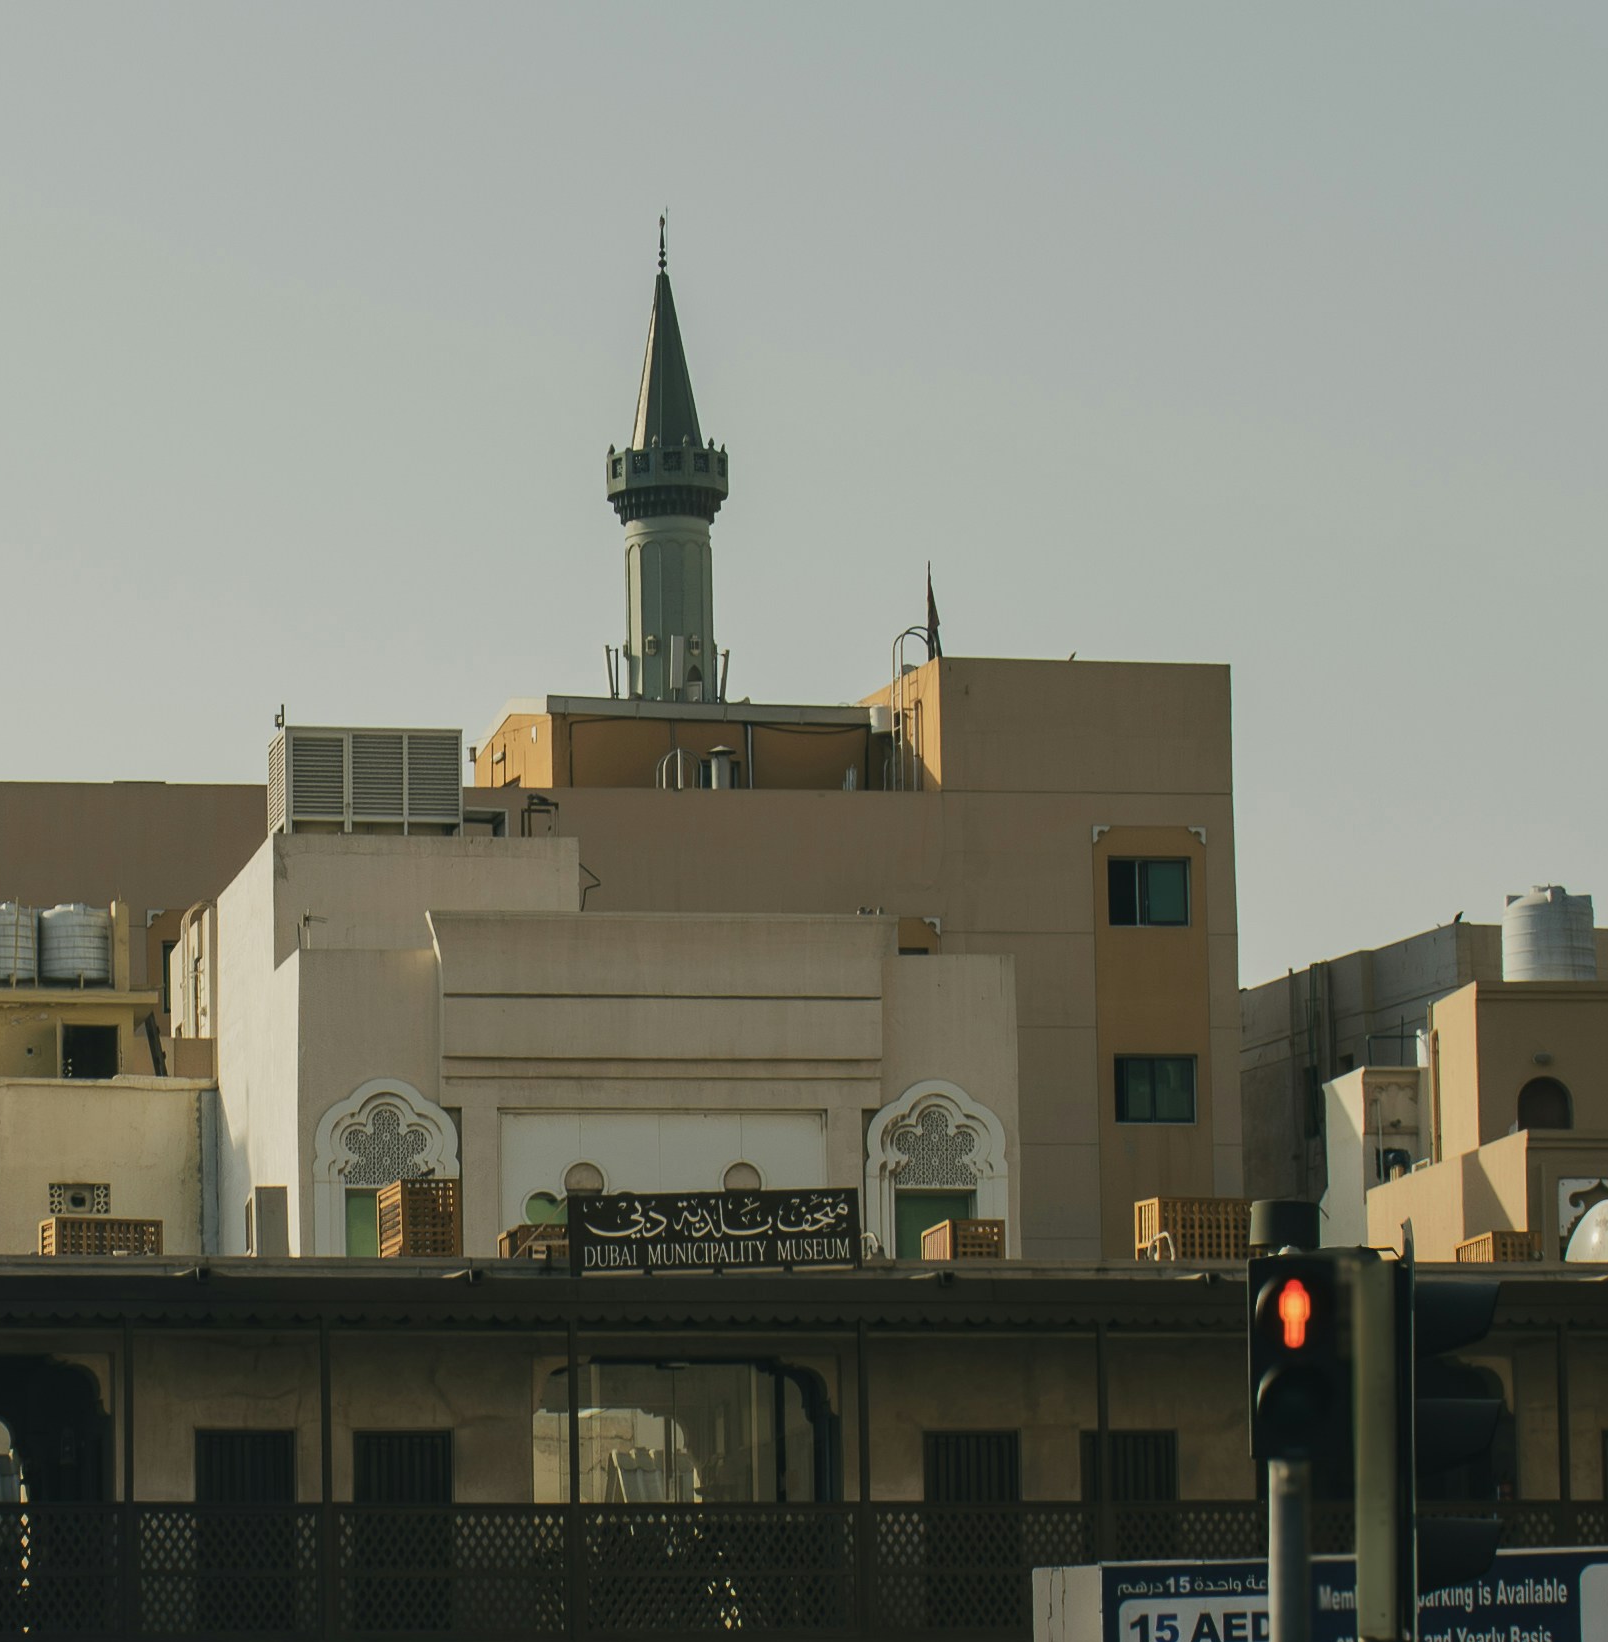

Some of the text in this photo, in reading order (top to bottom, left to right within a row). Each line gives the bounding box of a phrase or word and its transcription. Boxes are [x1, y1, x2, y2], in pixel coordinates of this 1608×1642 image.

[584, 1237, 850, 1267] DUBAI MUNICIPALITY MUSEUM
[1166, 1577, 1190, 1594] 15
[1478, 1580, 1491, 1605] is
[1497, 1578, 1568, 1605] Available
